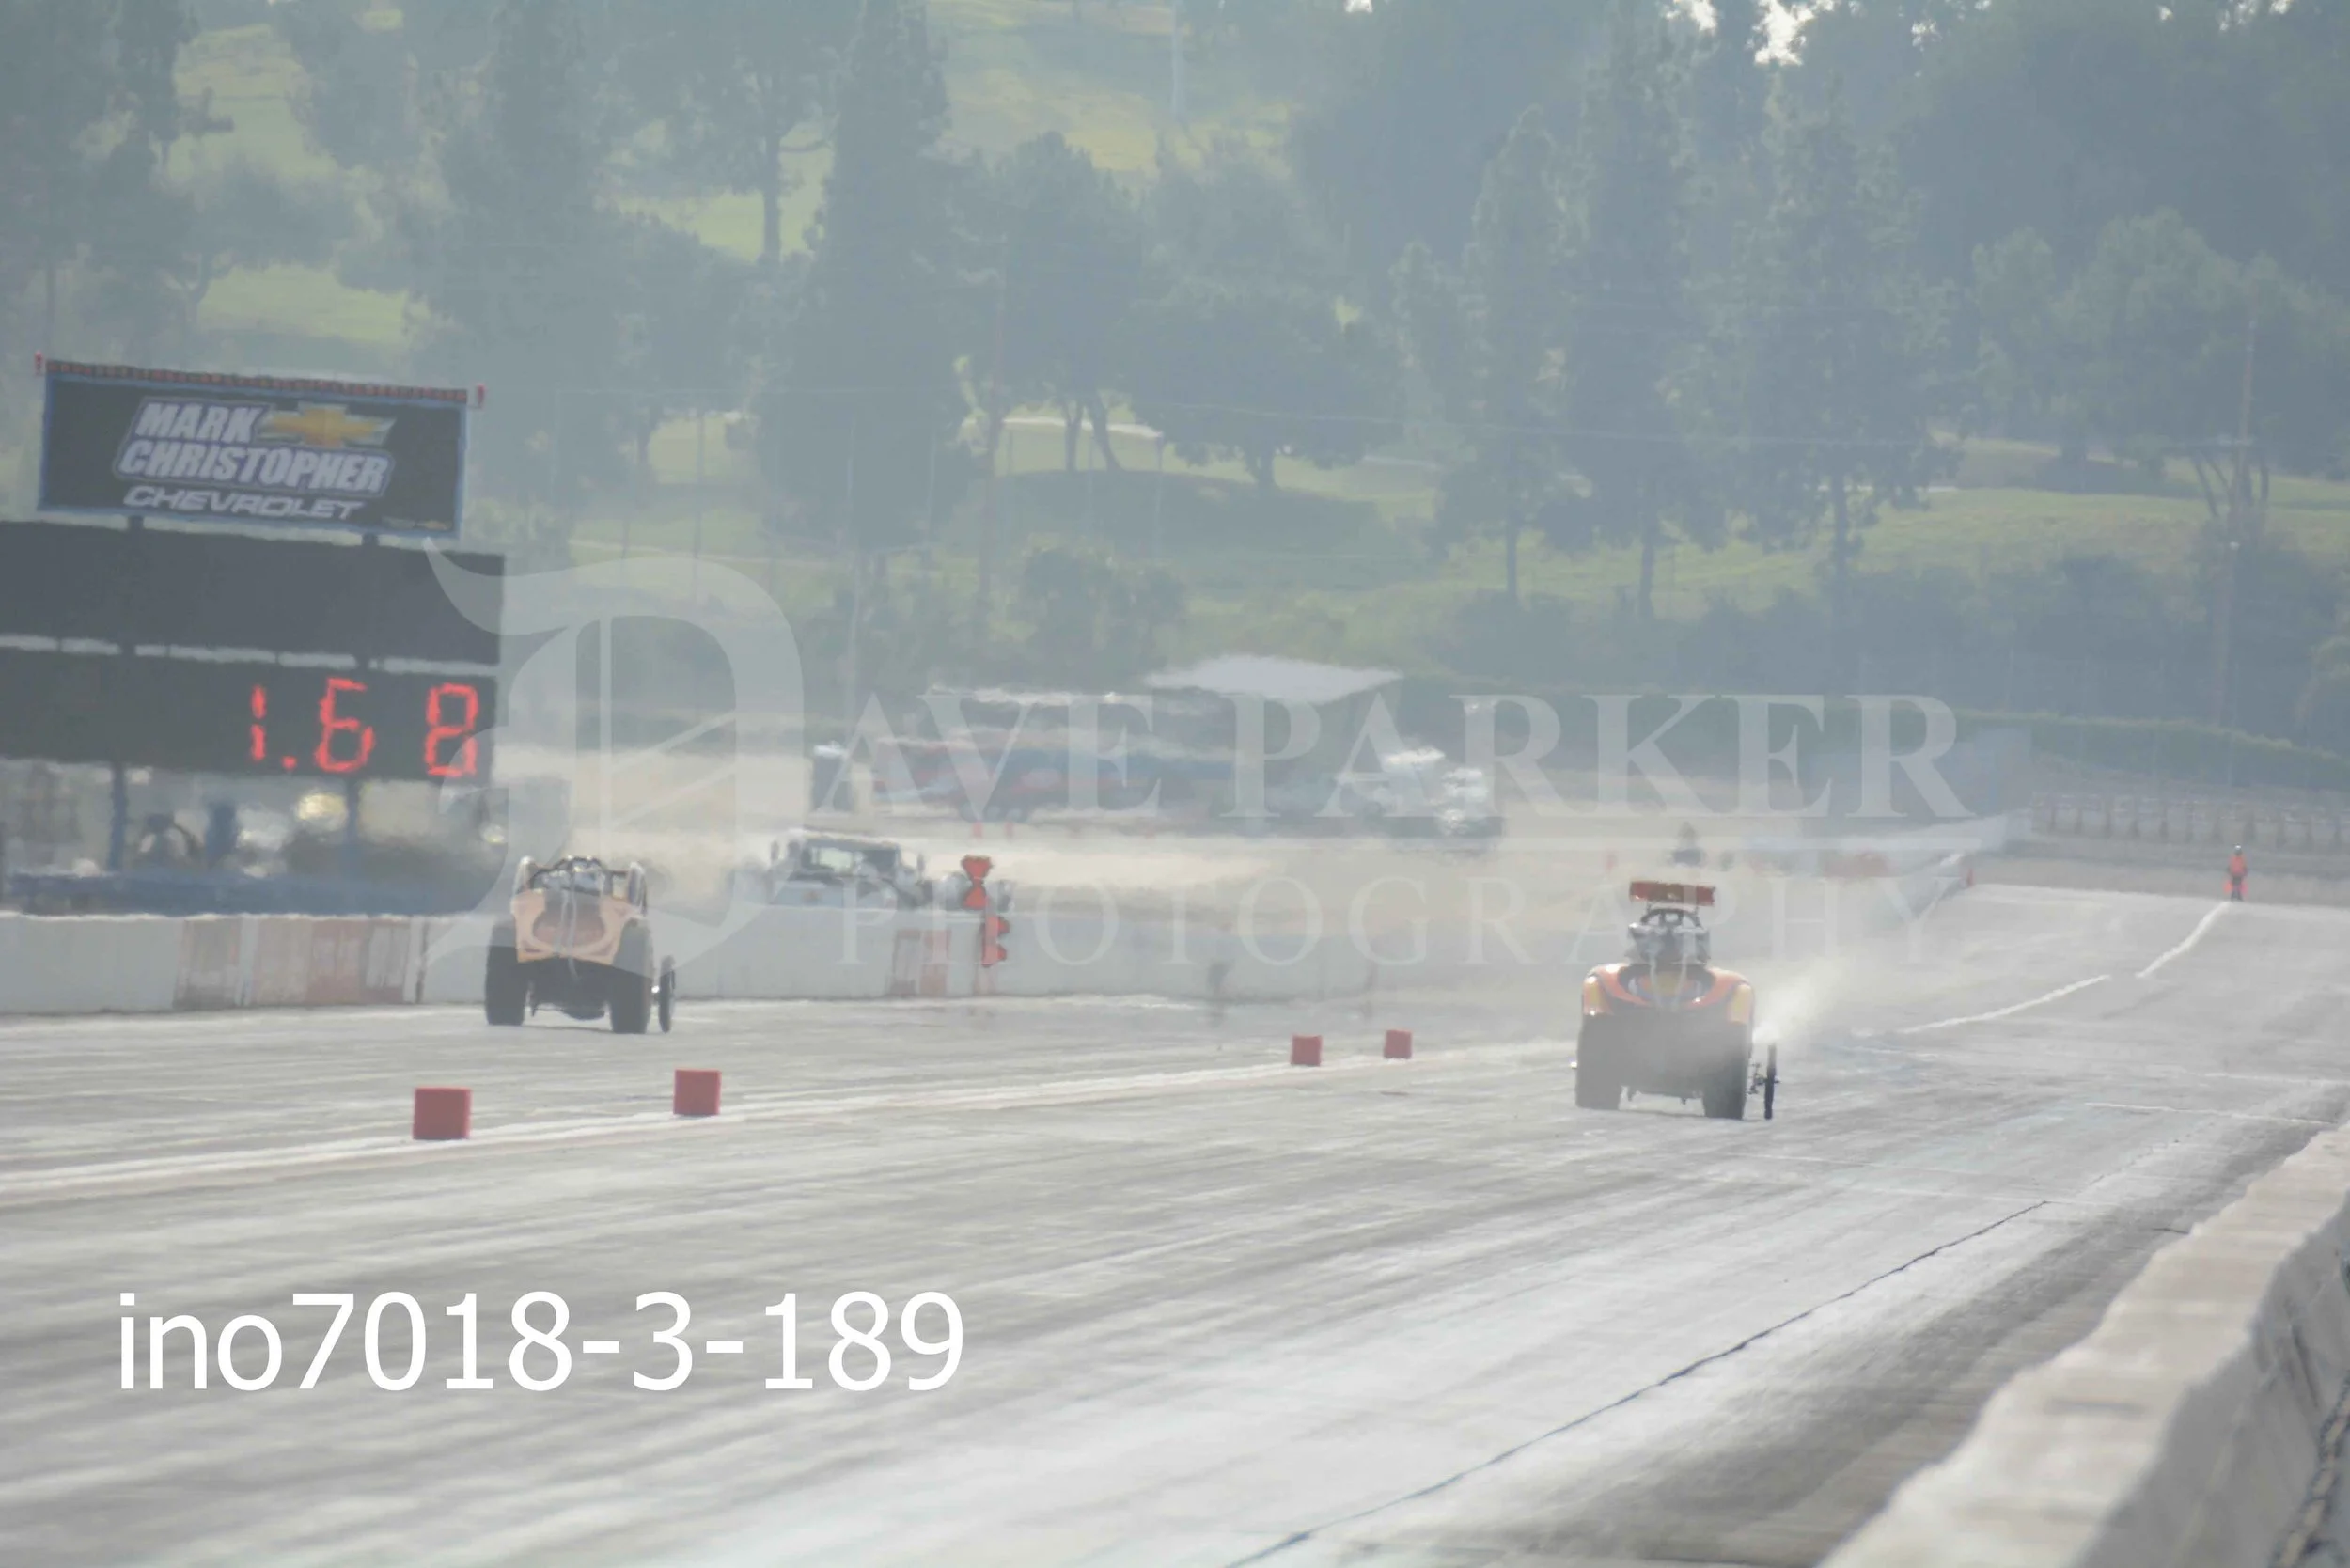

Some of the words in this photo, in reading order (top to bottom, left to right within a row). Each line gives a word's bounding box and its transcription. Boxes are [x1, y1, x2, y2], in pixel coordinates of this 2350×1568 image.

[135, 402, 263, 443] MARK
[119, 440, 390, 494] CHRISTOPHER
[123, 485, 366, 520] CHEVROLET
